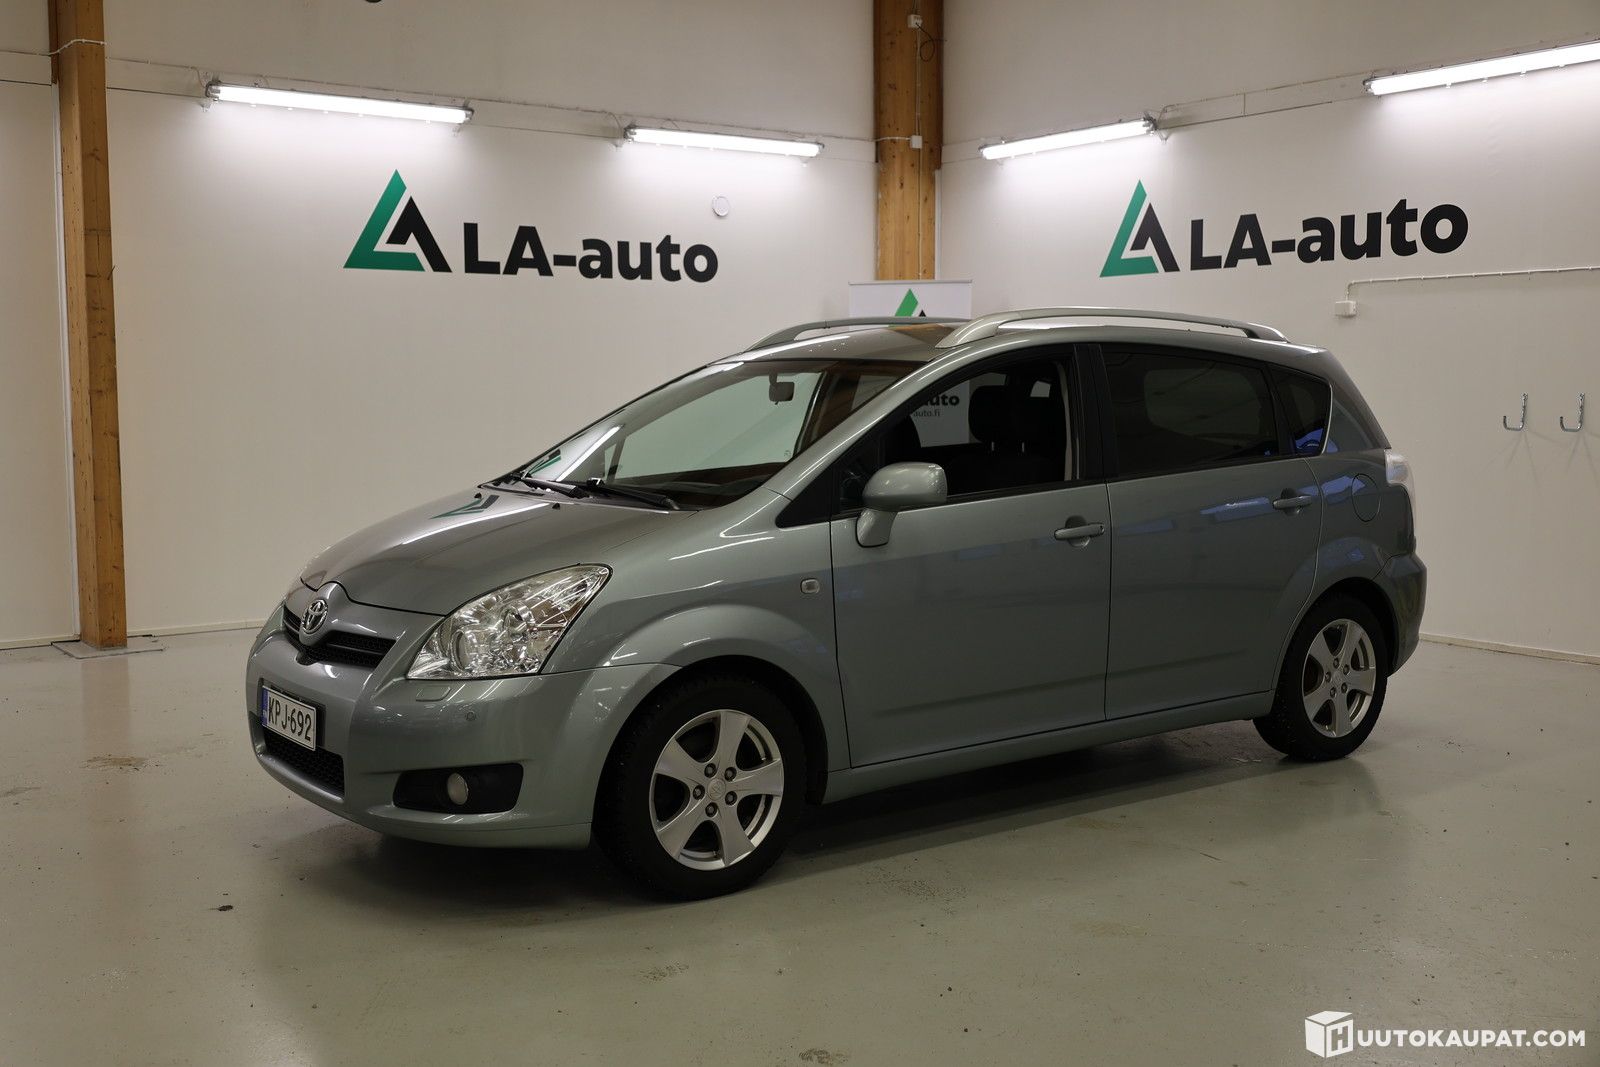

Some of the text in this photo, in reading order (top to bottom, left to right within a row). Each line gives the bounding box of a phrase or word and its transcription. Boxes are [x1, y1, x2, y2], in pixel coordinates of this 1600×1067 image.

[463, 222, 719, 283] LA-auto
[1190, 198, 1469, 271] LA-auto
[268, 696, 312, 741] KPJ-692
